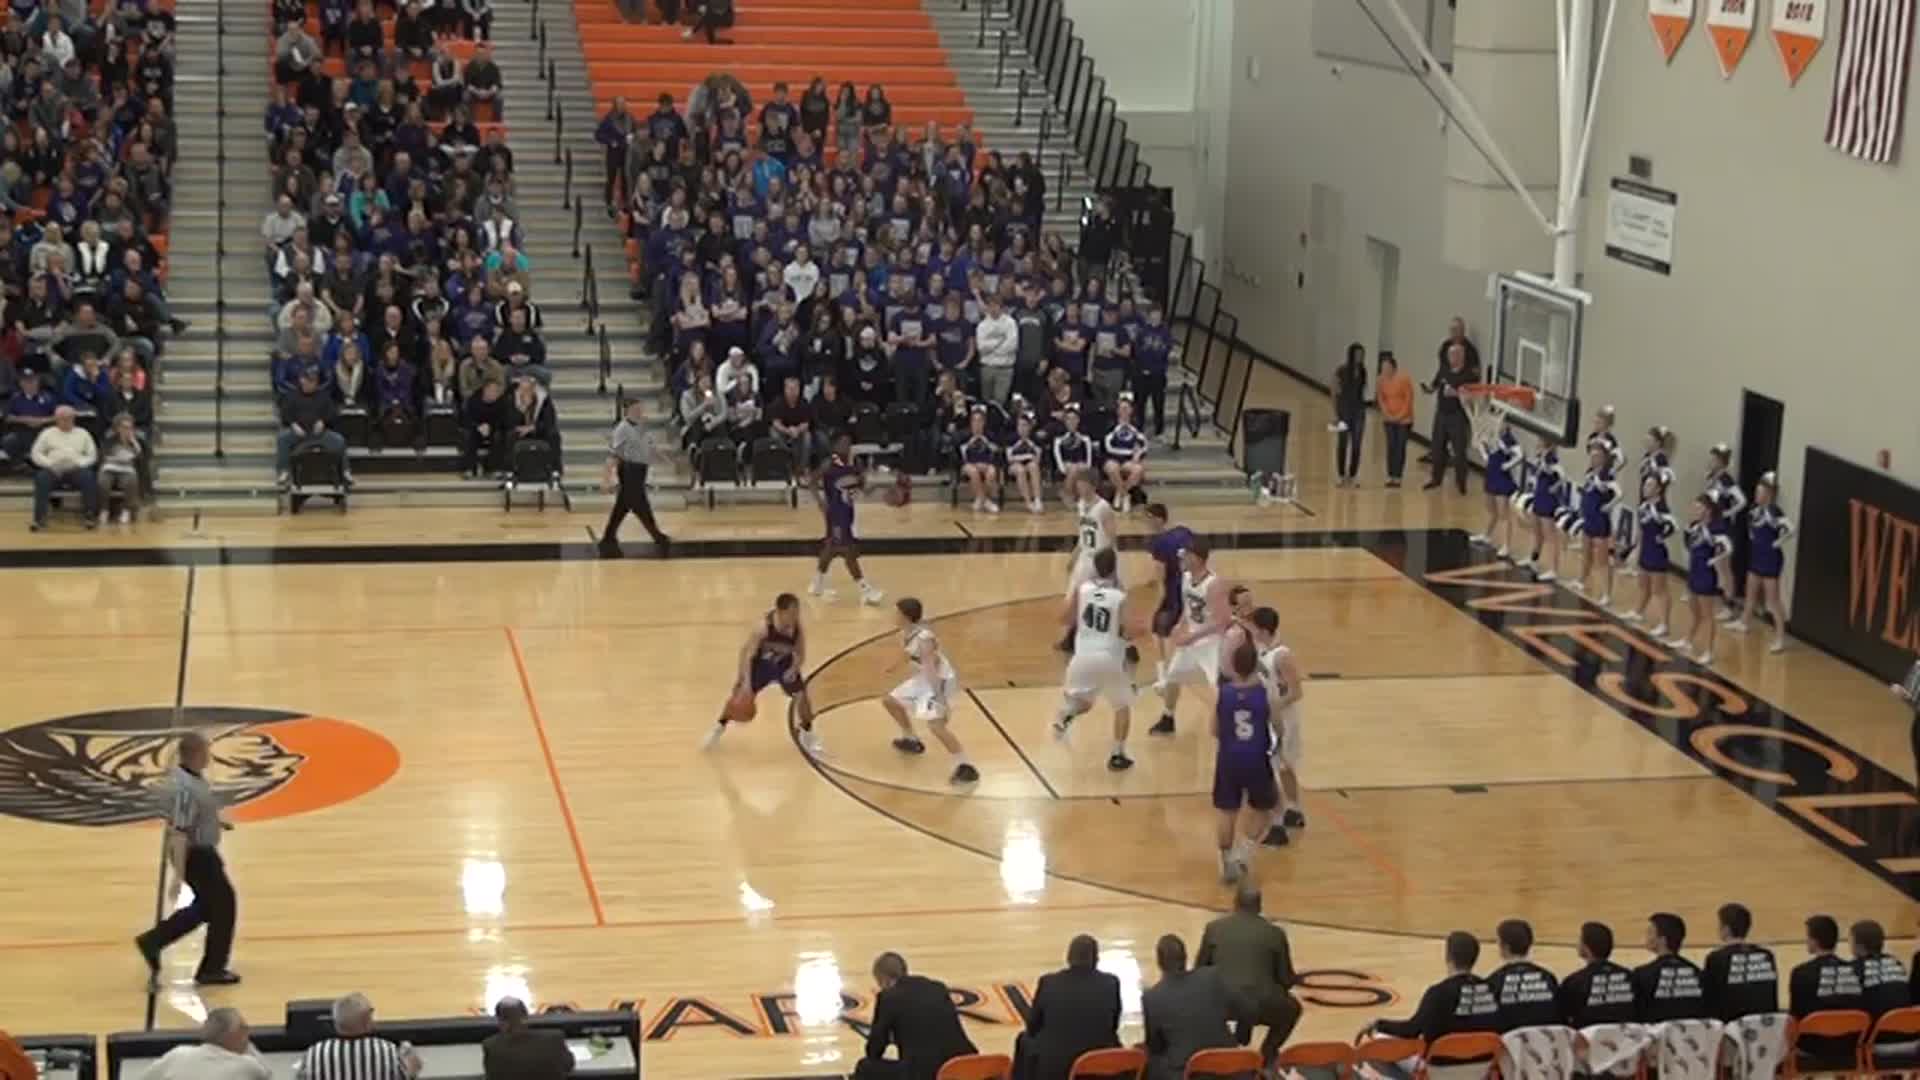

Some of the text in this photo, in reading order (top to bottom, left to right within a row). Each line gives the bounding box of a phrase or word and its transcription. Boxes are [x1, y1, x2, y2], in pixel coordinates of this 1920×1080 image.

[1848, 498, 1920, 656] WE
[1082, 603, 1111, 632] 40
[1233, 709, 1254, 740] 5
